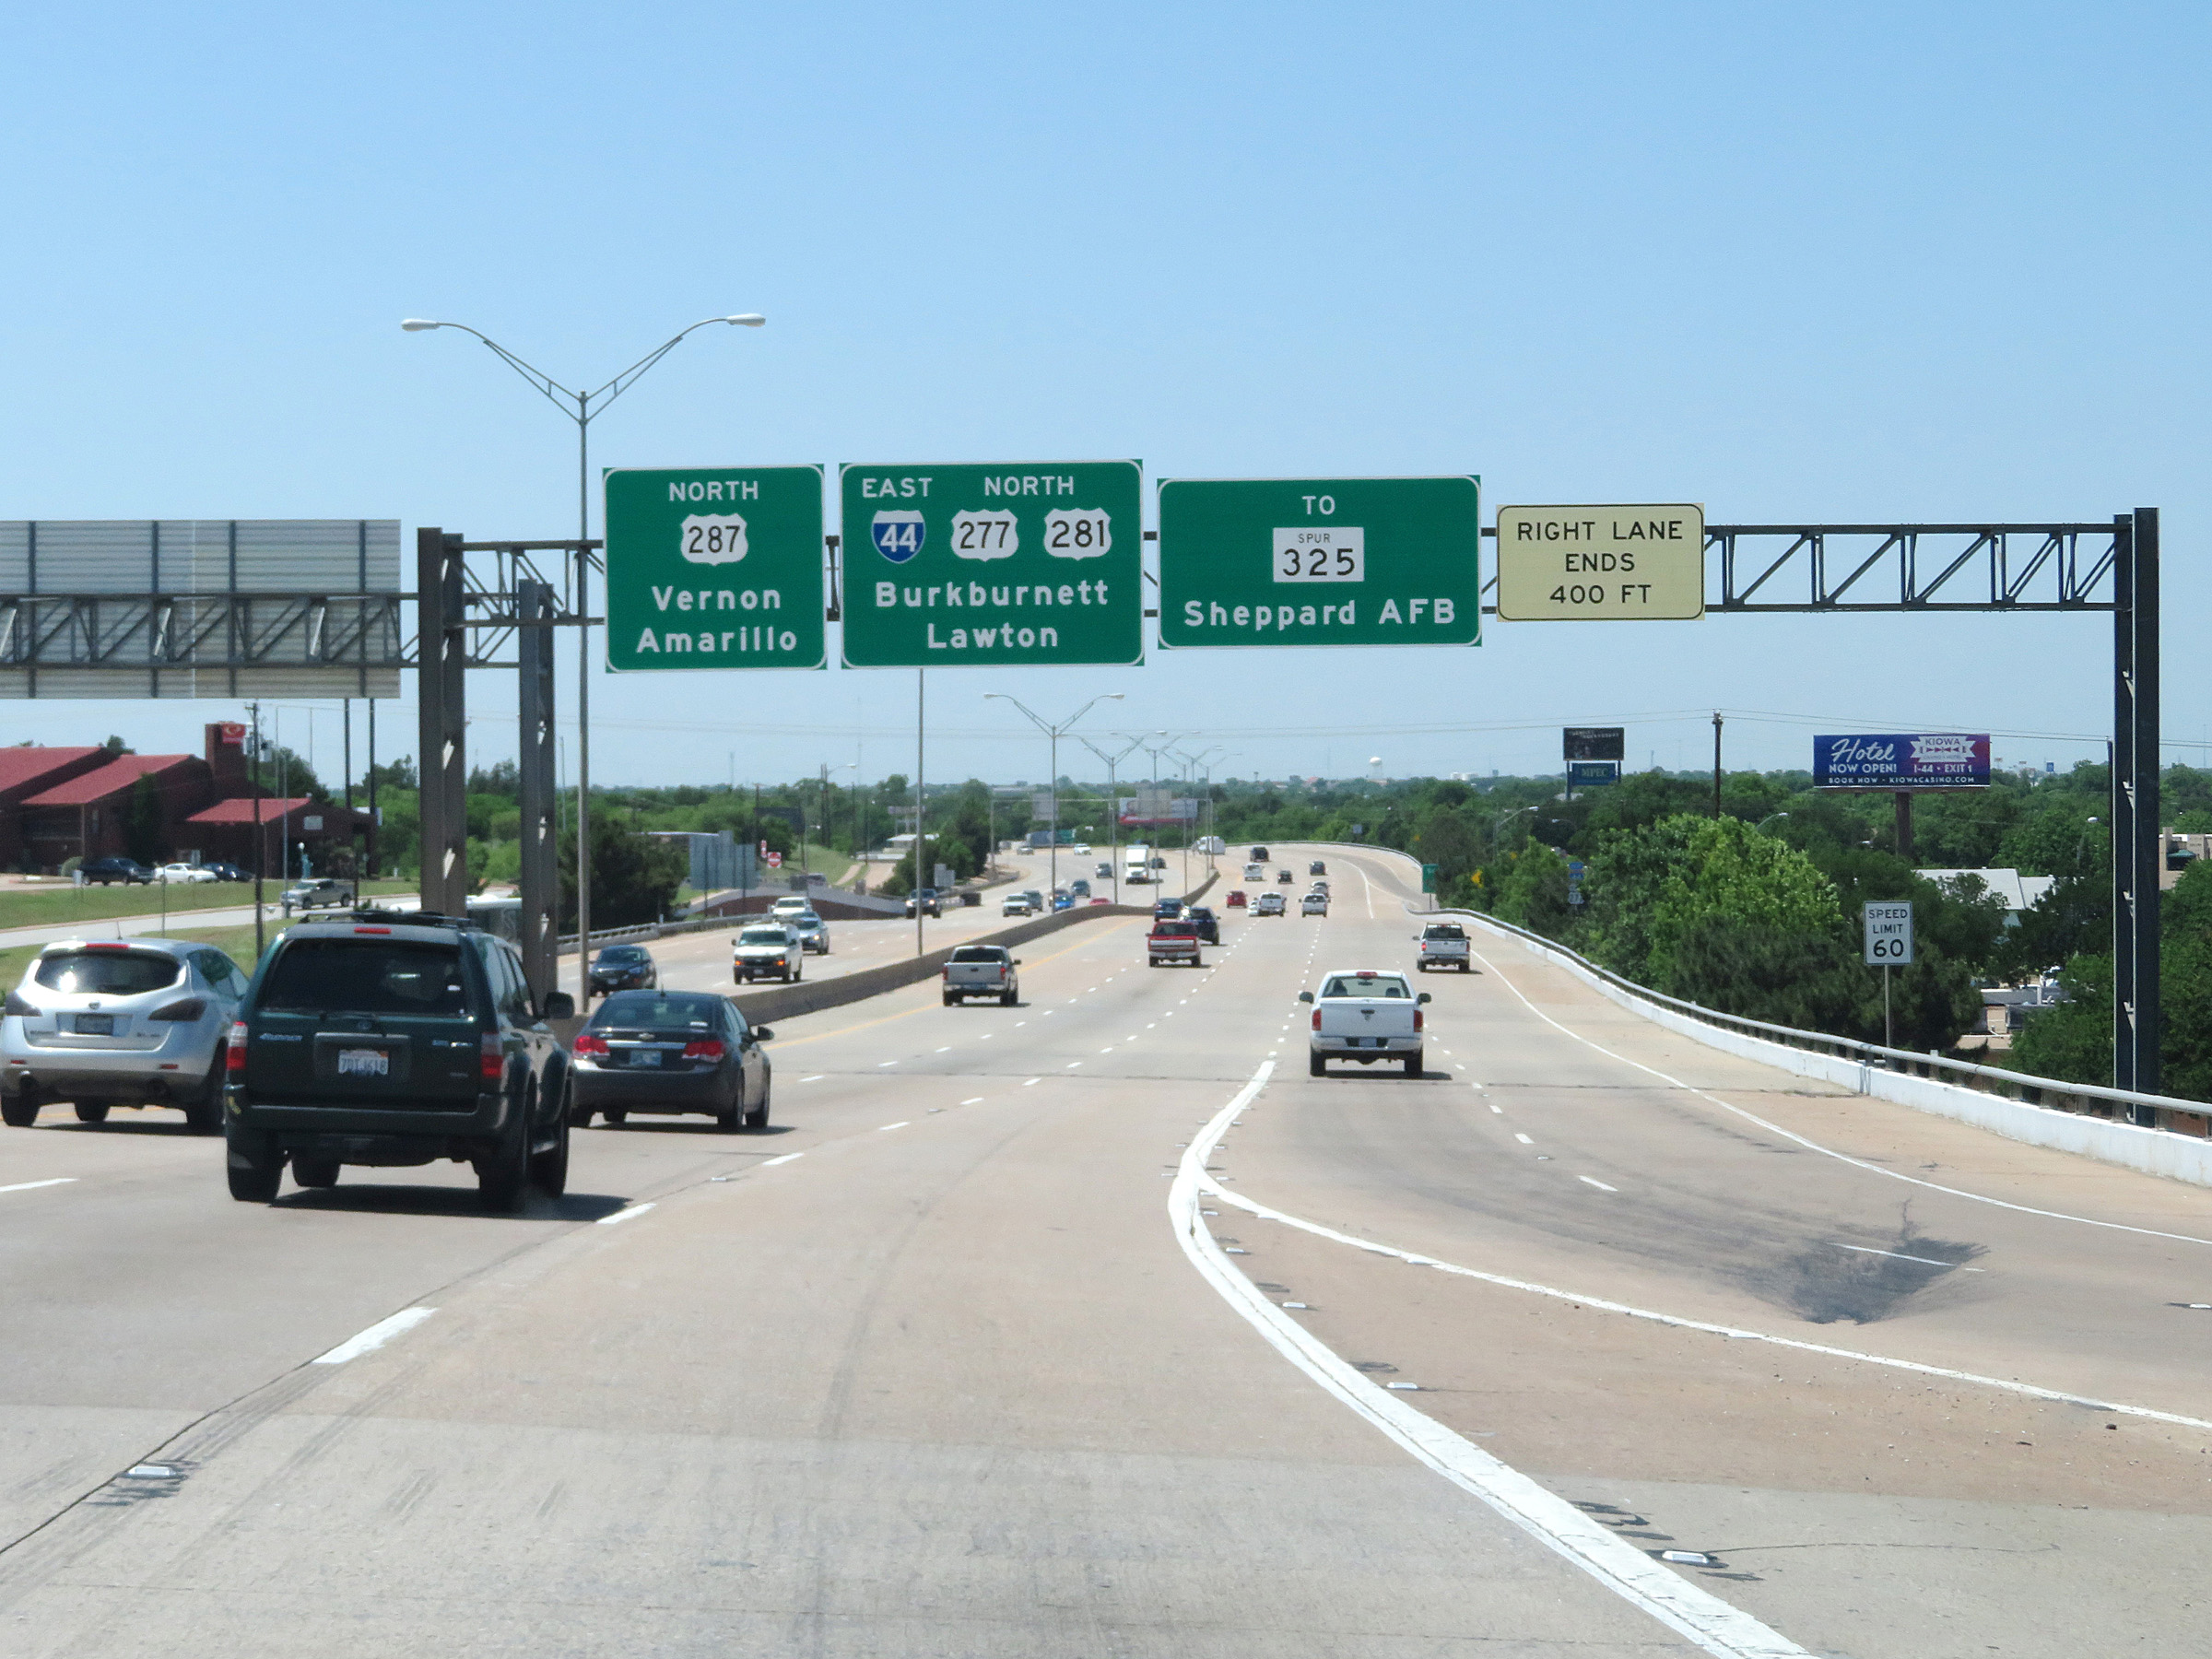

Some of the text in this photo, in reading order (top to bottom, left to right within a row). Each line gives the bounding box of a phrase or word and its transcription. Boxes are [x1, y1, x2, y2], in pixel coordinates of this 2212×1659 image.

[668, 480, 759, 501] NORTH
[862, 477, 933, 498] EAST
[984, 476, 1075, 496] NORTH
[1301, 495, 1335, 515] TO
[688, 524, 740, 554] 287
[880, 524, 917, 553] 44
[959, 521, 1010, 549] 277
[1051, 519, 1105, 548] 281
[1298, 533, 1331, 544] SPUR
[1517, 521, 1683, 541] RIGHT LANE
[1282, 547, 1355, 577] 325
[1566, 553, 1635, 572] ENDS
[651, 585, 782, 611] Vernon
[876, 580, 1109, 607] Burkburnett
[1549, 584, 1652, 605] 400 FT
[1184, 598, 1455, 631] Sheppard AFB
[636, 627, 797, 653] Amarillo
[927, 622, 1058, 649] Lawton
[1830, 738, 1895, 763] Hotel
[1925, 737, 1960, 746] KIOWA
[1829, 763, 1897, 773] NOW OPEN!
[1913, 764, 1973, 773] I-44 EXIT 1
[1868, 909, 1908, 919] SPEED
[1873, 924, 1903, 934] LIMIT
[1873, 938, 1904, 958] 60
